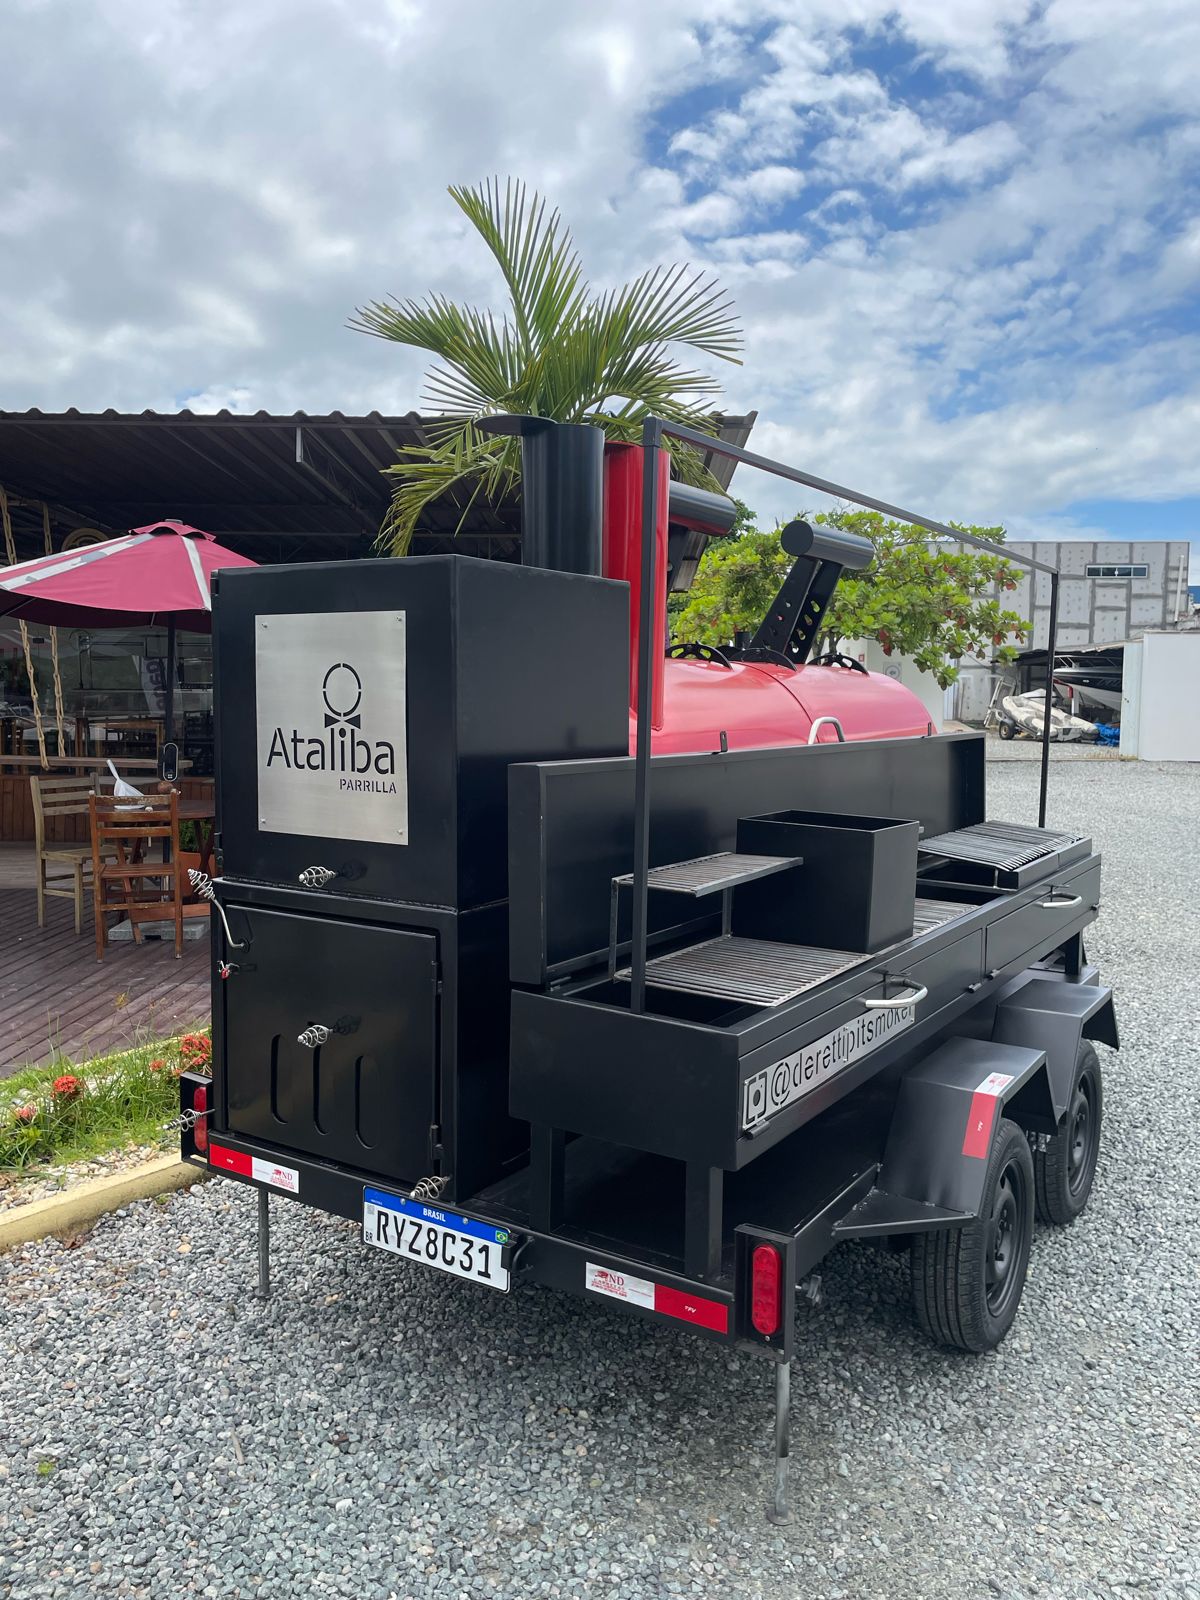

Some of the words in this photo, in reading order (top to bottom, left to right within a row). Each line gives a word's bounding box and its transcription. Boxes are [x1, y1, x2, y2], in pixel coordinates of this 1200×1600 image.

[266, 727, 395, 775] Ataliba
[339, 778, 397, 794] PARRILLA
[422, 1207, 446, 1223] BRASIL
[365, 1230, 373, 1242] BR
[376, 1210, 492, 1279] RYZ8C31
[609, 1273, 625, 1286] ND
